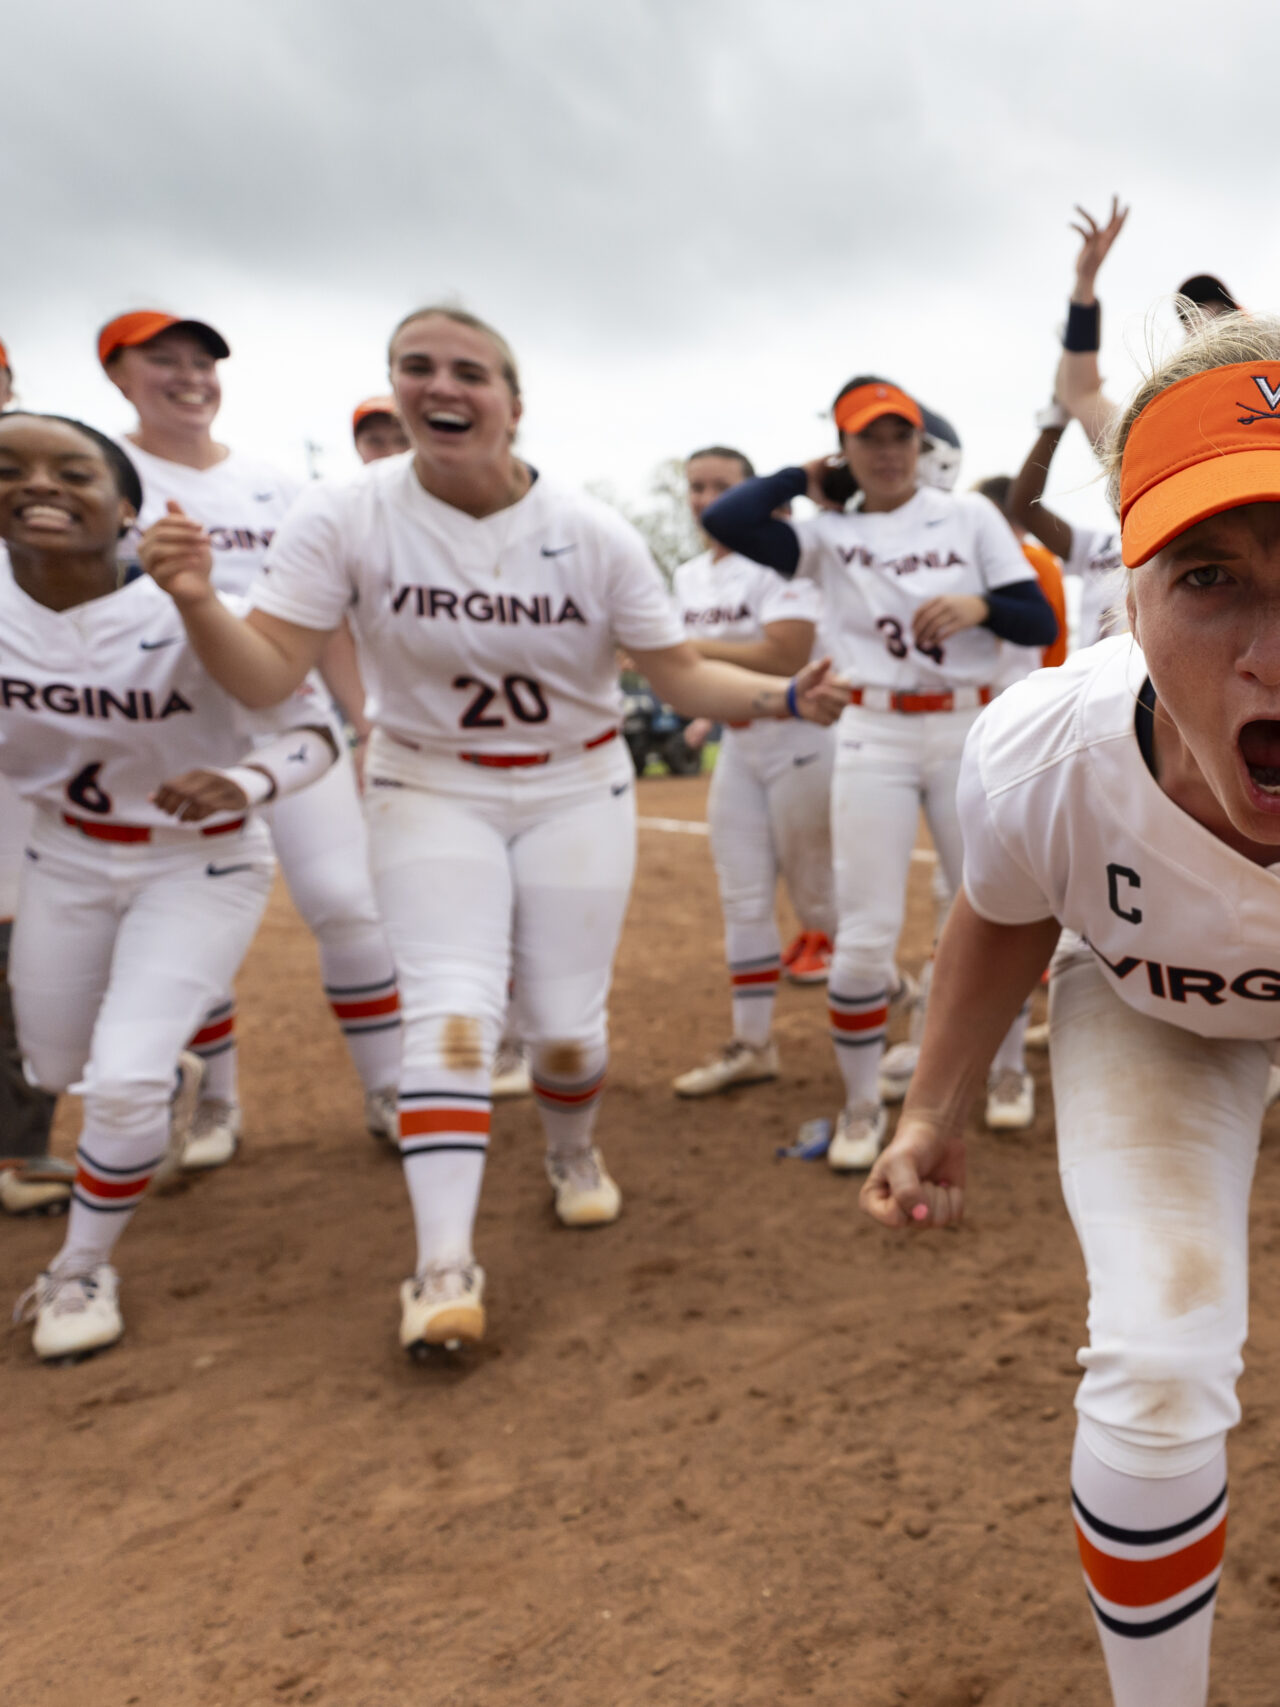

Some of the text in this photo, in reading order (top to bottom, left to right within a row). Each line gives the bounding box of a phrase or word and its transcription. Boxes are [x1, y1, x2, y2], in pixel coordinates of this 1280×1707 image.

[0, 677, 194, 722] RGINIA
[452, 671, 549, 731] 20
[66, 760, 113, 816] 6
[1106, 862, 1143, 925] C
